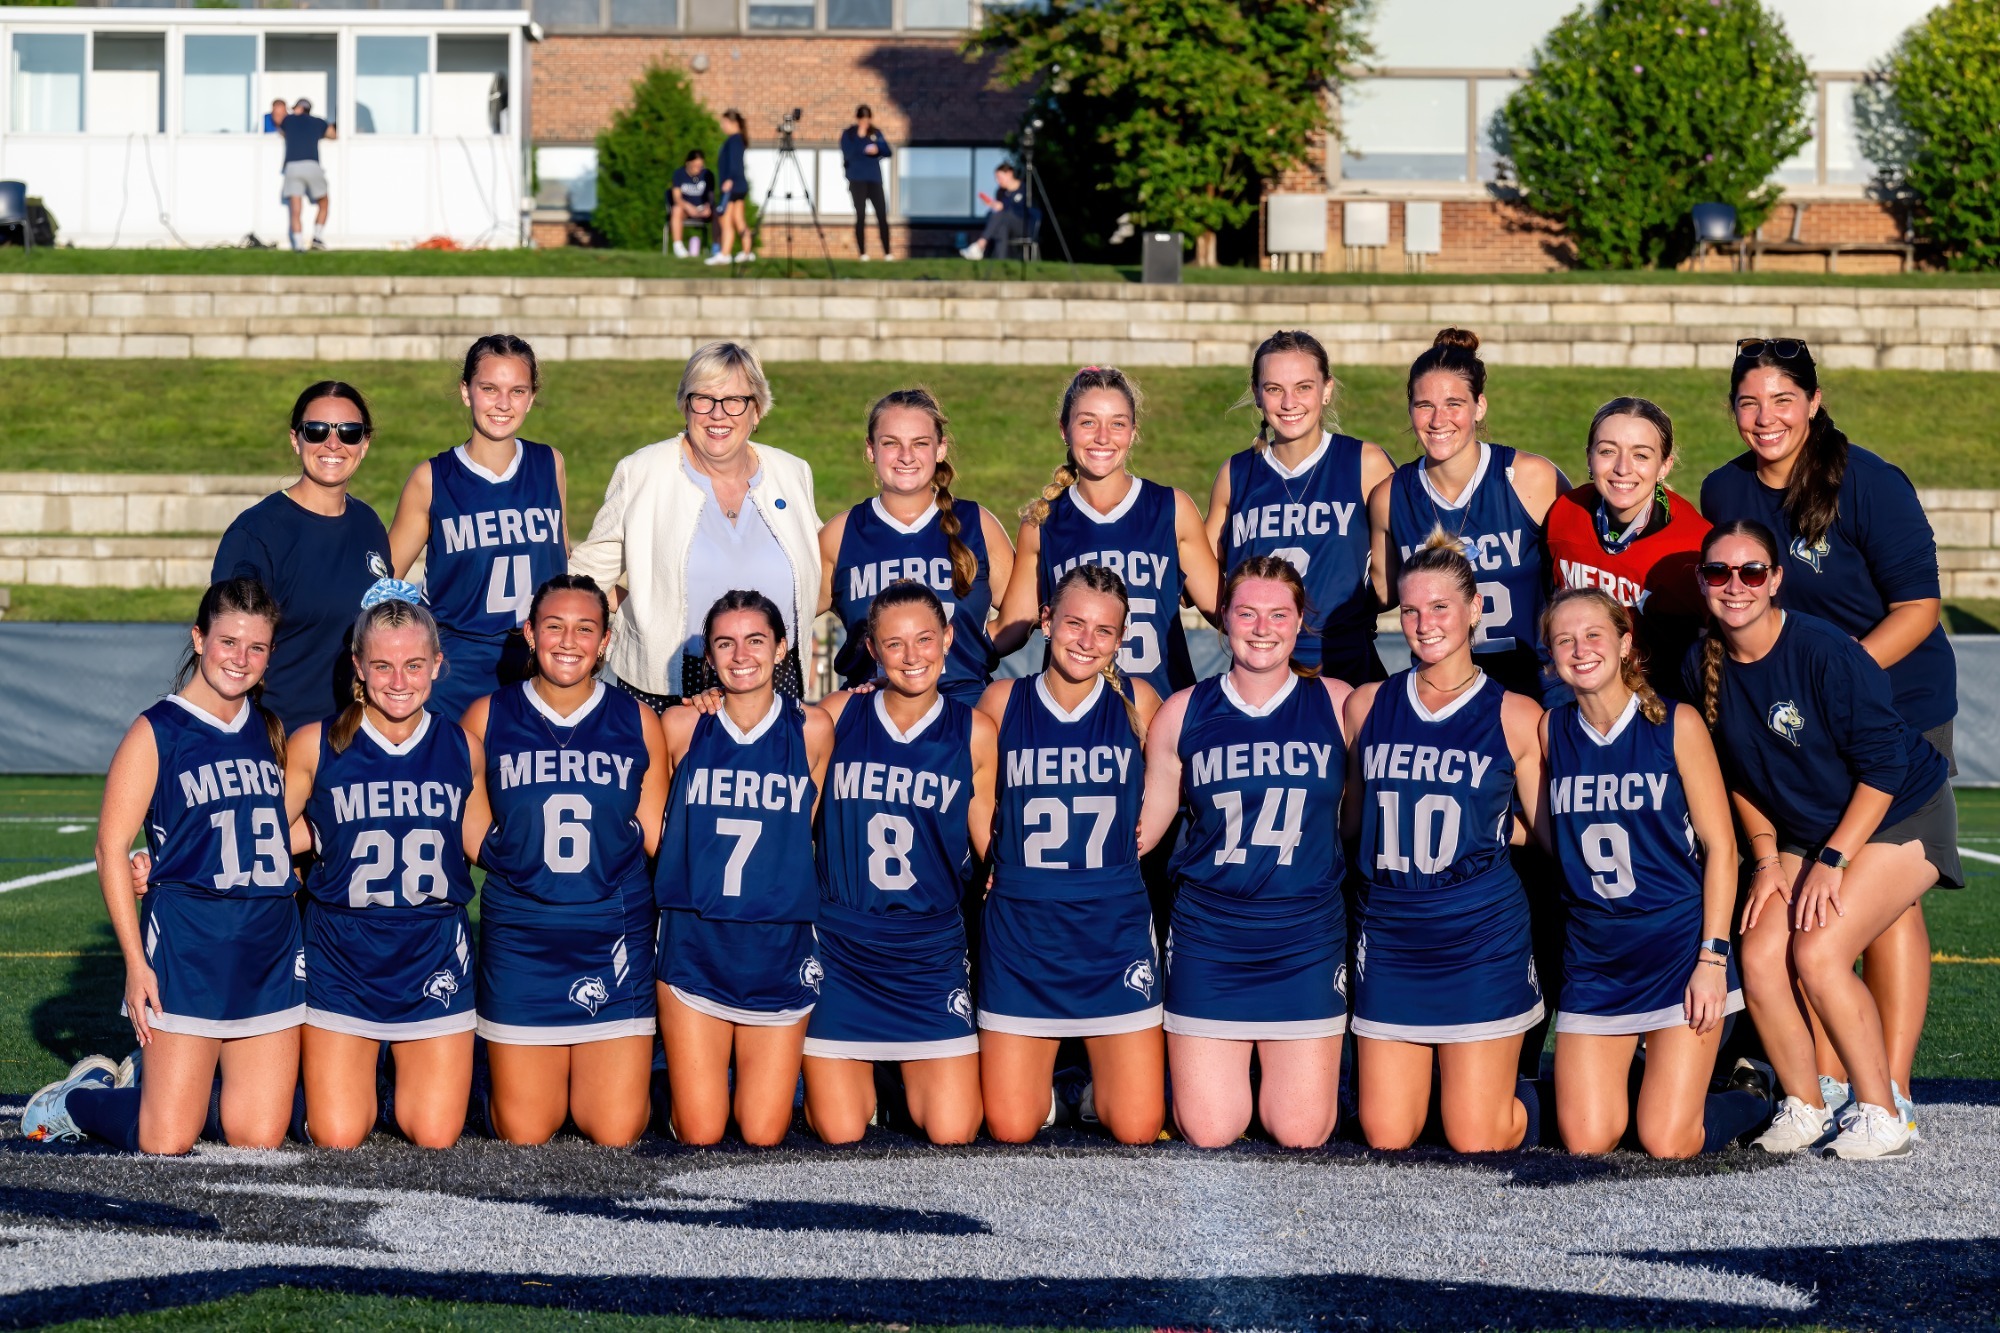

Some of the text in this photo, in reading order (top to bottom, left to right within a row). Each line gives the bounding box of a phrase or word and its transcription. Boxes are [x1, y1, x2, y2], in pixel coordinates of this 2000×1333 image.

[441, 508, 560, 554] MERCY
[1232, 501, 1356, 548] MERCY
[486, 555, 534, 628] 4
[850, 557, 952, 601] MERC
[1559, 558, 1652, 616] MERCY
[1115, 598, 1162, 673] 5
[179, 759, 285, 808] MERCY
[500, 750, 634, 792] MERCY
[686, 768, 809, 812] MERCY
[834, 763, 961, 813] MERCY
[1007, 746, 1131, 787] MERCY
[1192, 742, 1331, 786] MERCY
[1365, 744, 1492, 788] MERCY
[331, 781, 462, 823] MERCY
[1550, 772, 1669, 815] MERCY
[210, 808, 290, 889] 13
[543, 793, 592, 874] 6
[867, 813, 917, 890] 8
[1024, 796, 1117, 869] 27
[1213, 788, 1308, 865] 14
[1377, 792, 1461, 874] 10
[349, 829, 448, 907] 28
[716, 818, 763, 896] 7
[1581, 823, 1636, 899] 9
